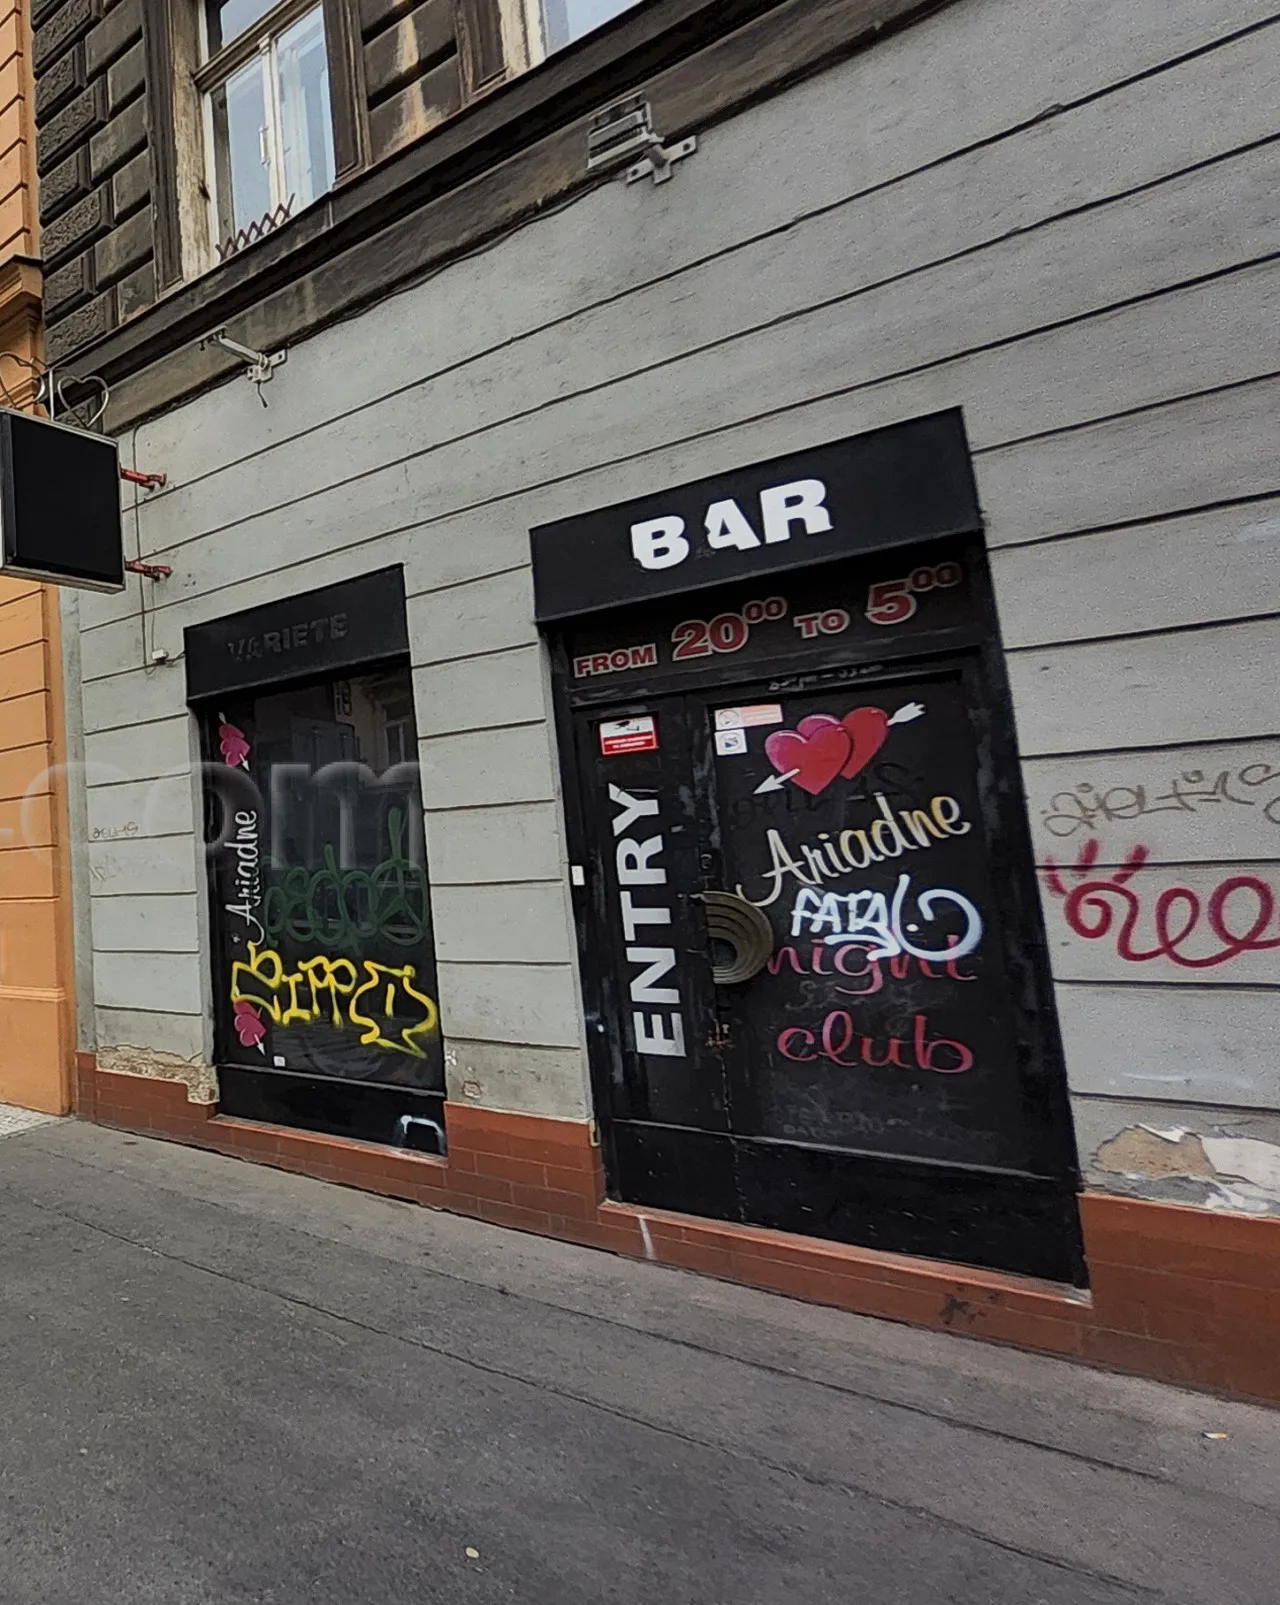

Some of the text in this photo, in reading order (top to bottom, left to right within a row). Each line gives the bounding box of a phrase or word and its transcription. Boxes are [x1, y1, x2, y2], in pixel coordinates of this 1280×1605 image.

[630, 478, 834, 571] BAR
[227, 612, 349, 664] VARIETE
[574, 643, 658, 678] FROM
[793, 609, 851, 639] TO
[224, 810, 265, 946] Ariadne
[735, 791, 972, 907] Ariadne
[608, 783, 687, 1058] ENTRY
[777, 1010, 974, 1074] club
